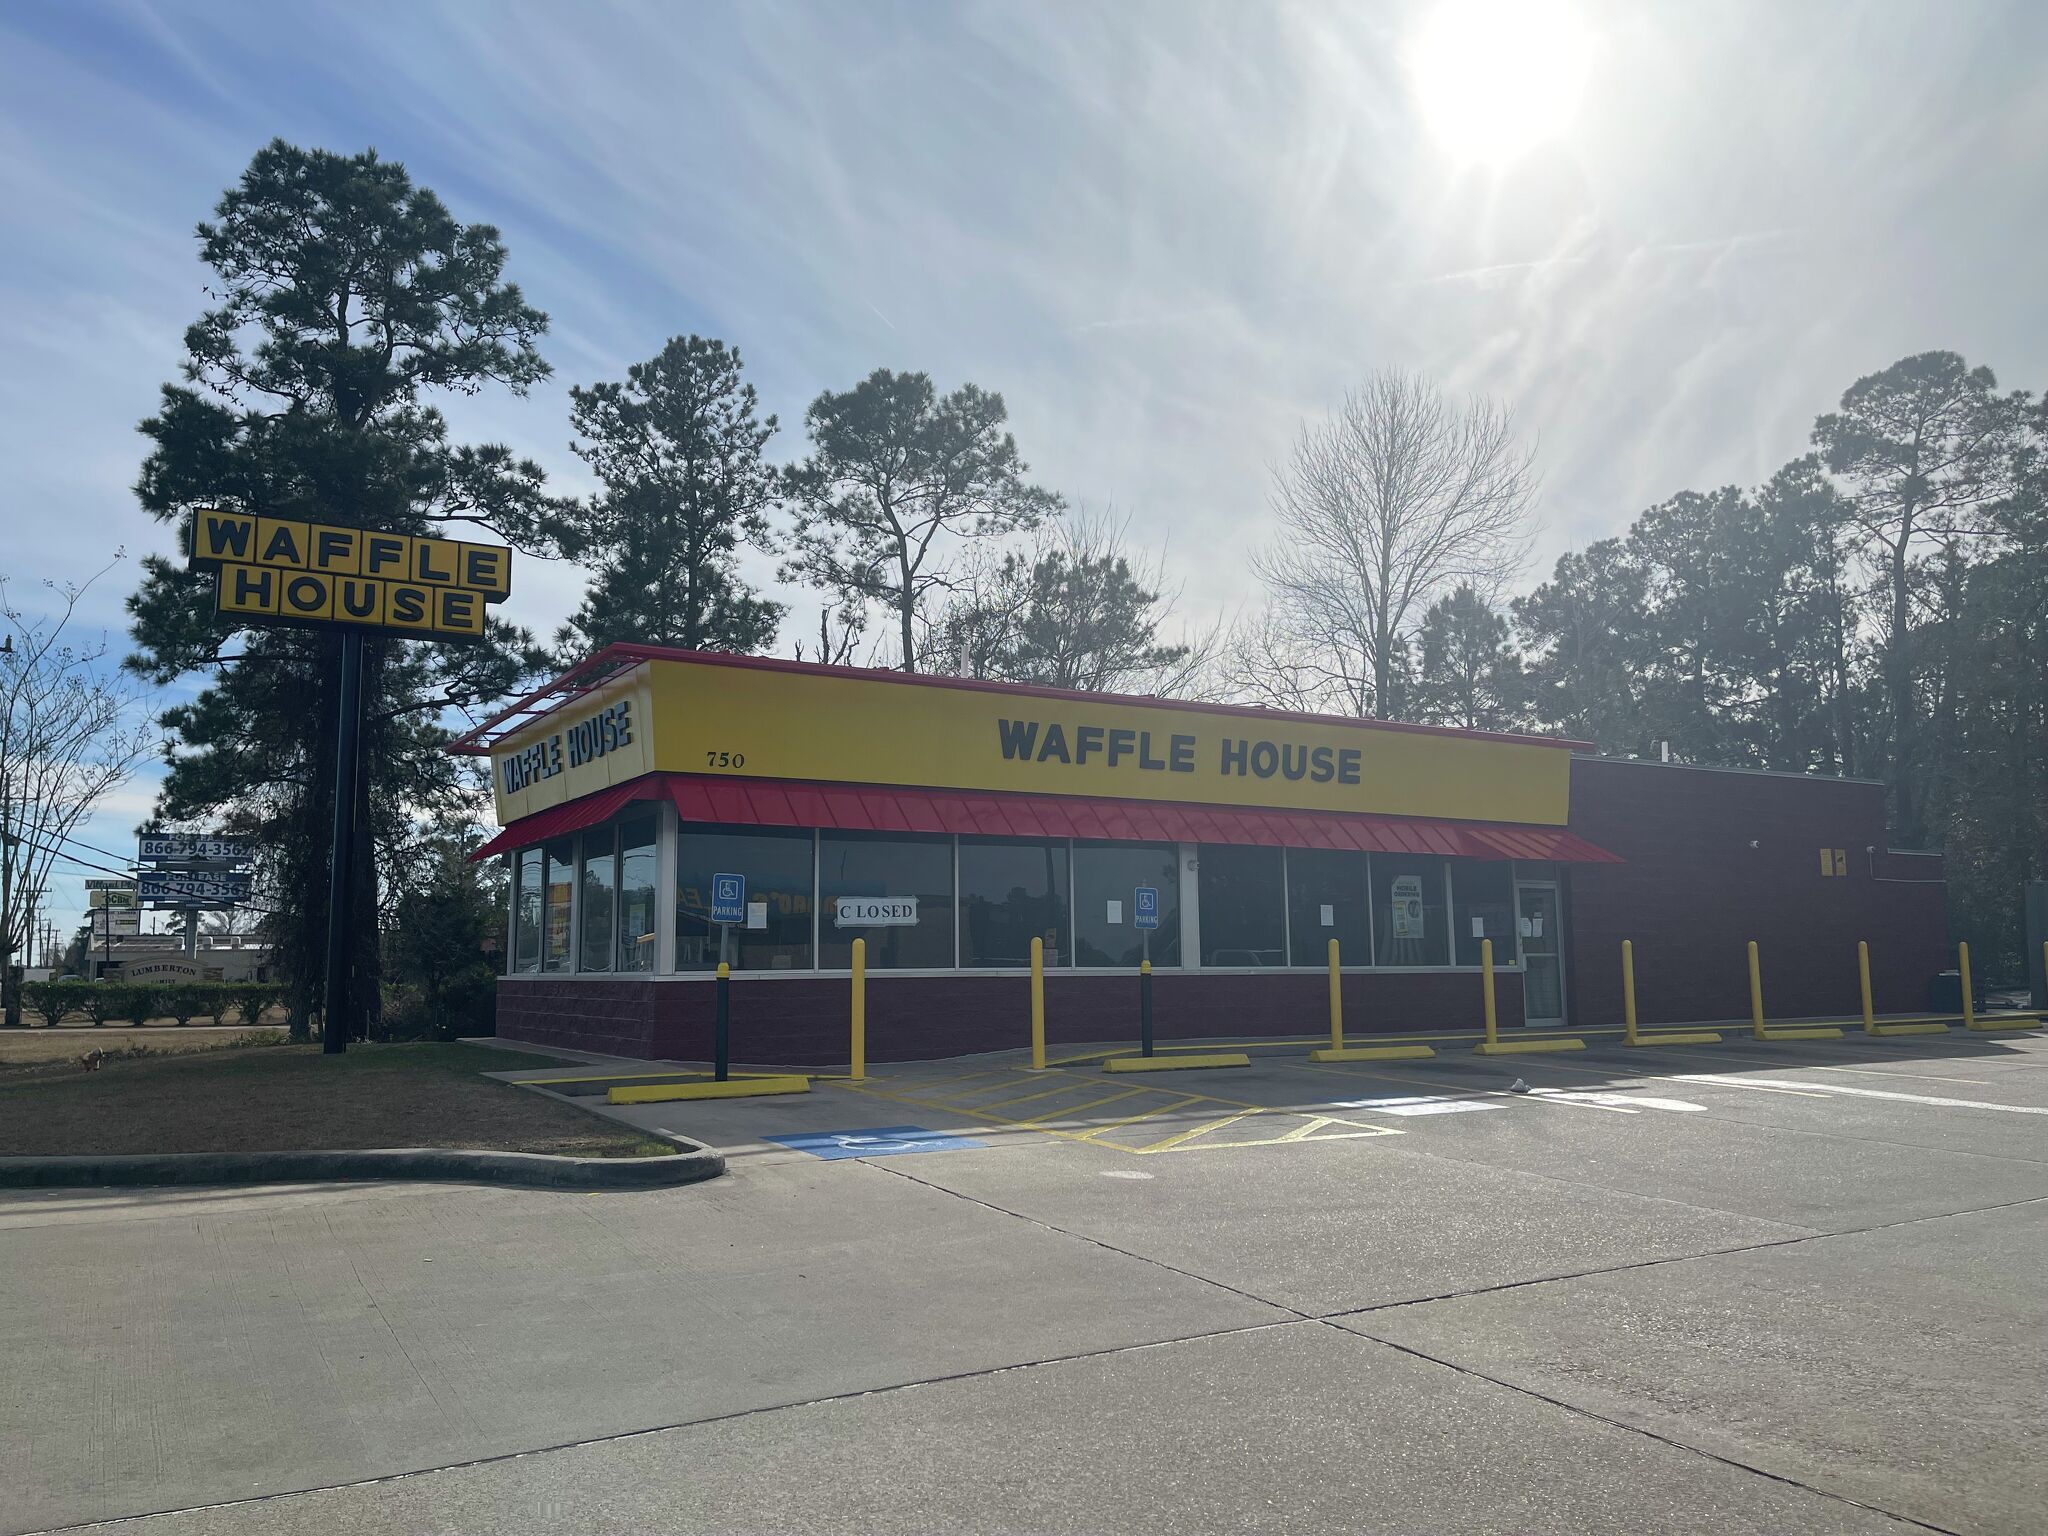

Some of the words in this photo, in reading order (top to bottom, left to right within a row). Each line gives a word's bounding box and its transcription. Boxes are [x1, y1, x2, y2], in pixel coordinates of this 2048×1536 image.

[206, 517, 499, 587] WAFFLE
[234, 569, 474, 629] HOUSE
[503, 734, 563, 795] WAFFLE
[566, 700, 632, 769] HOUSE
[998, 718, 1196, 773] WAFFLE
[1220, 738, 1362, 785] HOUSE
[707, 751, 745, 769] 750
[144, 842, 252, 856] 866-794-3567
[713, 905, 743, 917] PARKING
[1136, 916, 1158, 924] PARKING
[131, 964, 197, 977] LUMBERTON
